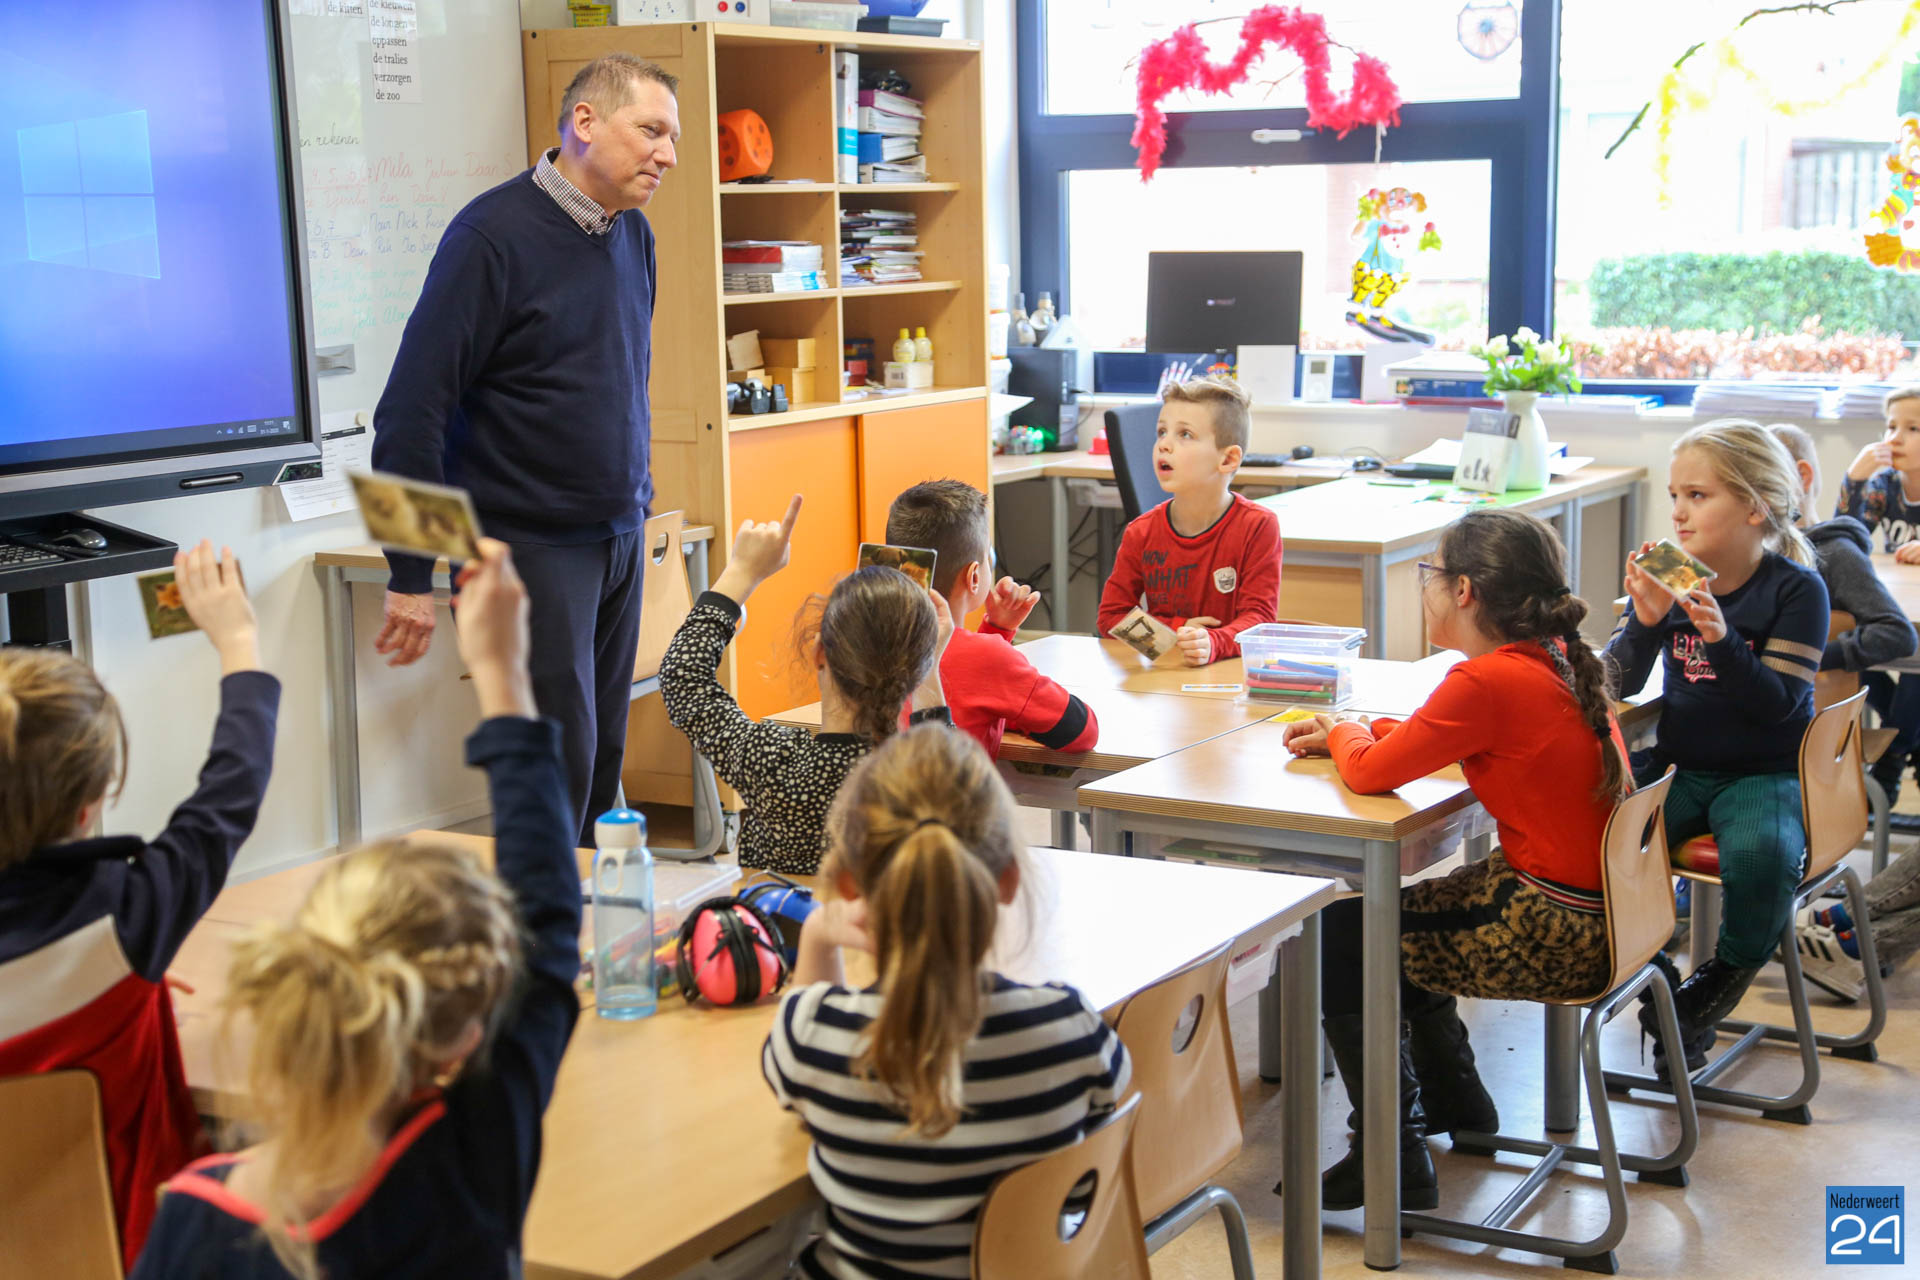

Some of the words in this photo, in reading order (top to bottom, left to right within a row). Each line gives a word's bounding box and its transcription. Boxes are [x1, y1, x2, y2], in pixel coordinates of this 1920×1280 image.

[371, 16, 380, 27] de
[372, 37, 408, 49] oppassen
[373, 52, 383, 63] de
[384, 53, 408, 65] tralies
[374, 73, 412, 86] verzorgen
[376, 89, 385, 100] de
[387, 92, 401, 101] zoo
[1142, 563, 1199, 592] WHAT
